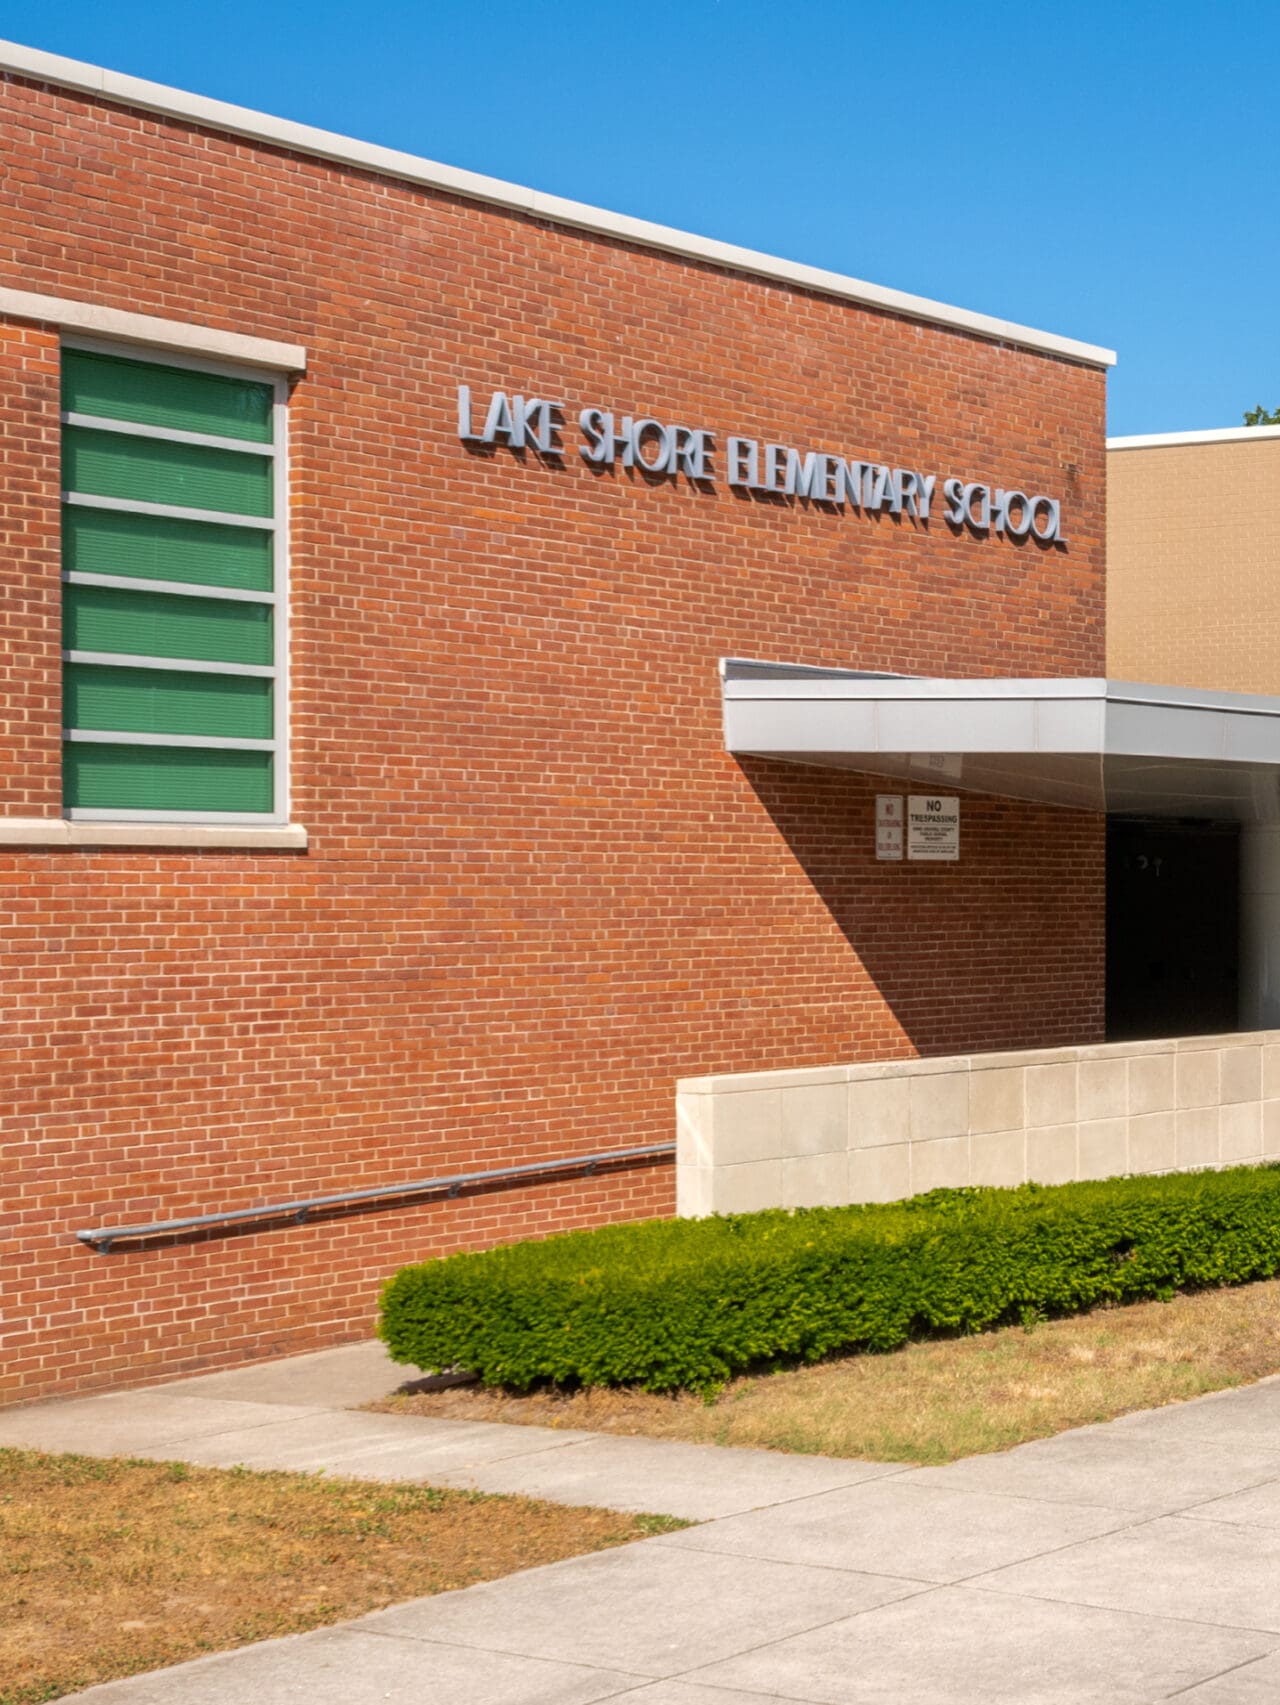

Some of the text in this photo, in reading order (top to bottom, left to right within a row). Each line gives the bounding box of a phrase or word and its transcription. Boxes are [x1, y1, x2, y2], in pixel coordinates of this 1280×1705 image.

[458, 384, 1068, 543] LAKE SHORE ELEMENTARY SCHOOL
[926, 800, 942, 812] NO
[911, 814, 958, 824] TRESPASSING
